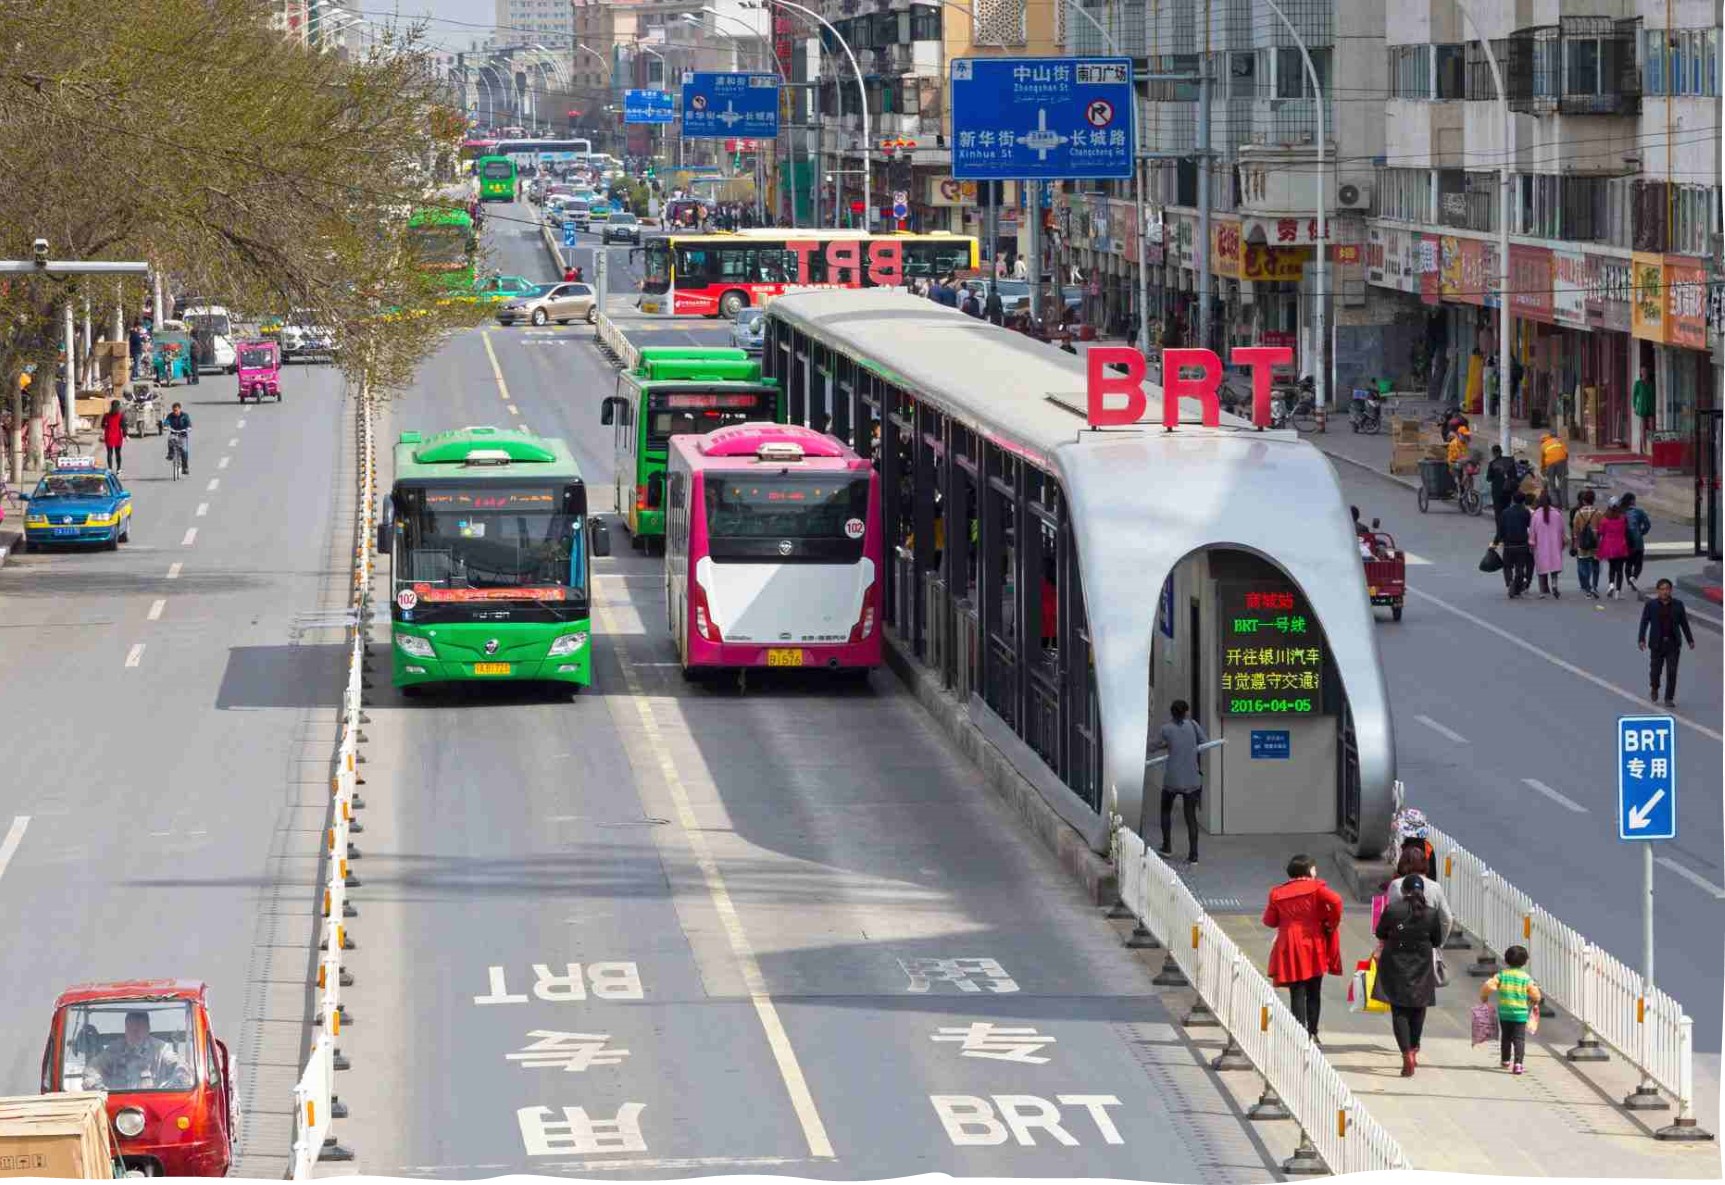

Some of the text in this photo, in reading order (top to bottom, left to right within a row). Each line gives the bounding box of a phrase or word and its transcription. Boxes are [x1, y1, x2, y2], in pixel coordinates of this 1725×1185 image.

[1013, 65, 1069, 82] 中山街
[1077, 65, 1127, 82] 南门广场
[1058, 83, 1069, 92] St
[959, 130, 1014, 148] 新华街
[1069, 129, 1126, 147] 长城路
[959, 149, 1013, 159] Xinhua St
[1087, 346, 1293, 428] BRT
[845, 523, 863, 534] 102
[398, 593, 416, 606] 102
[1226, 647, 1321, 666] 开往银川汽车
[1230, 699, 1312, 713] 2016-04-05
[1624, 728, 1669, 752] BRT
[1626, 757, 1667, 779] 专用
[473, 961, 644, 1005] BRT
[504, 1029, 632, 1072] 专
[929, 1021, 1057, 1064] 专
[516, 1101, 648, 1156] 用
[929, 1094, 1125, 1146] BRT
